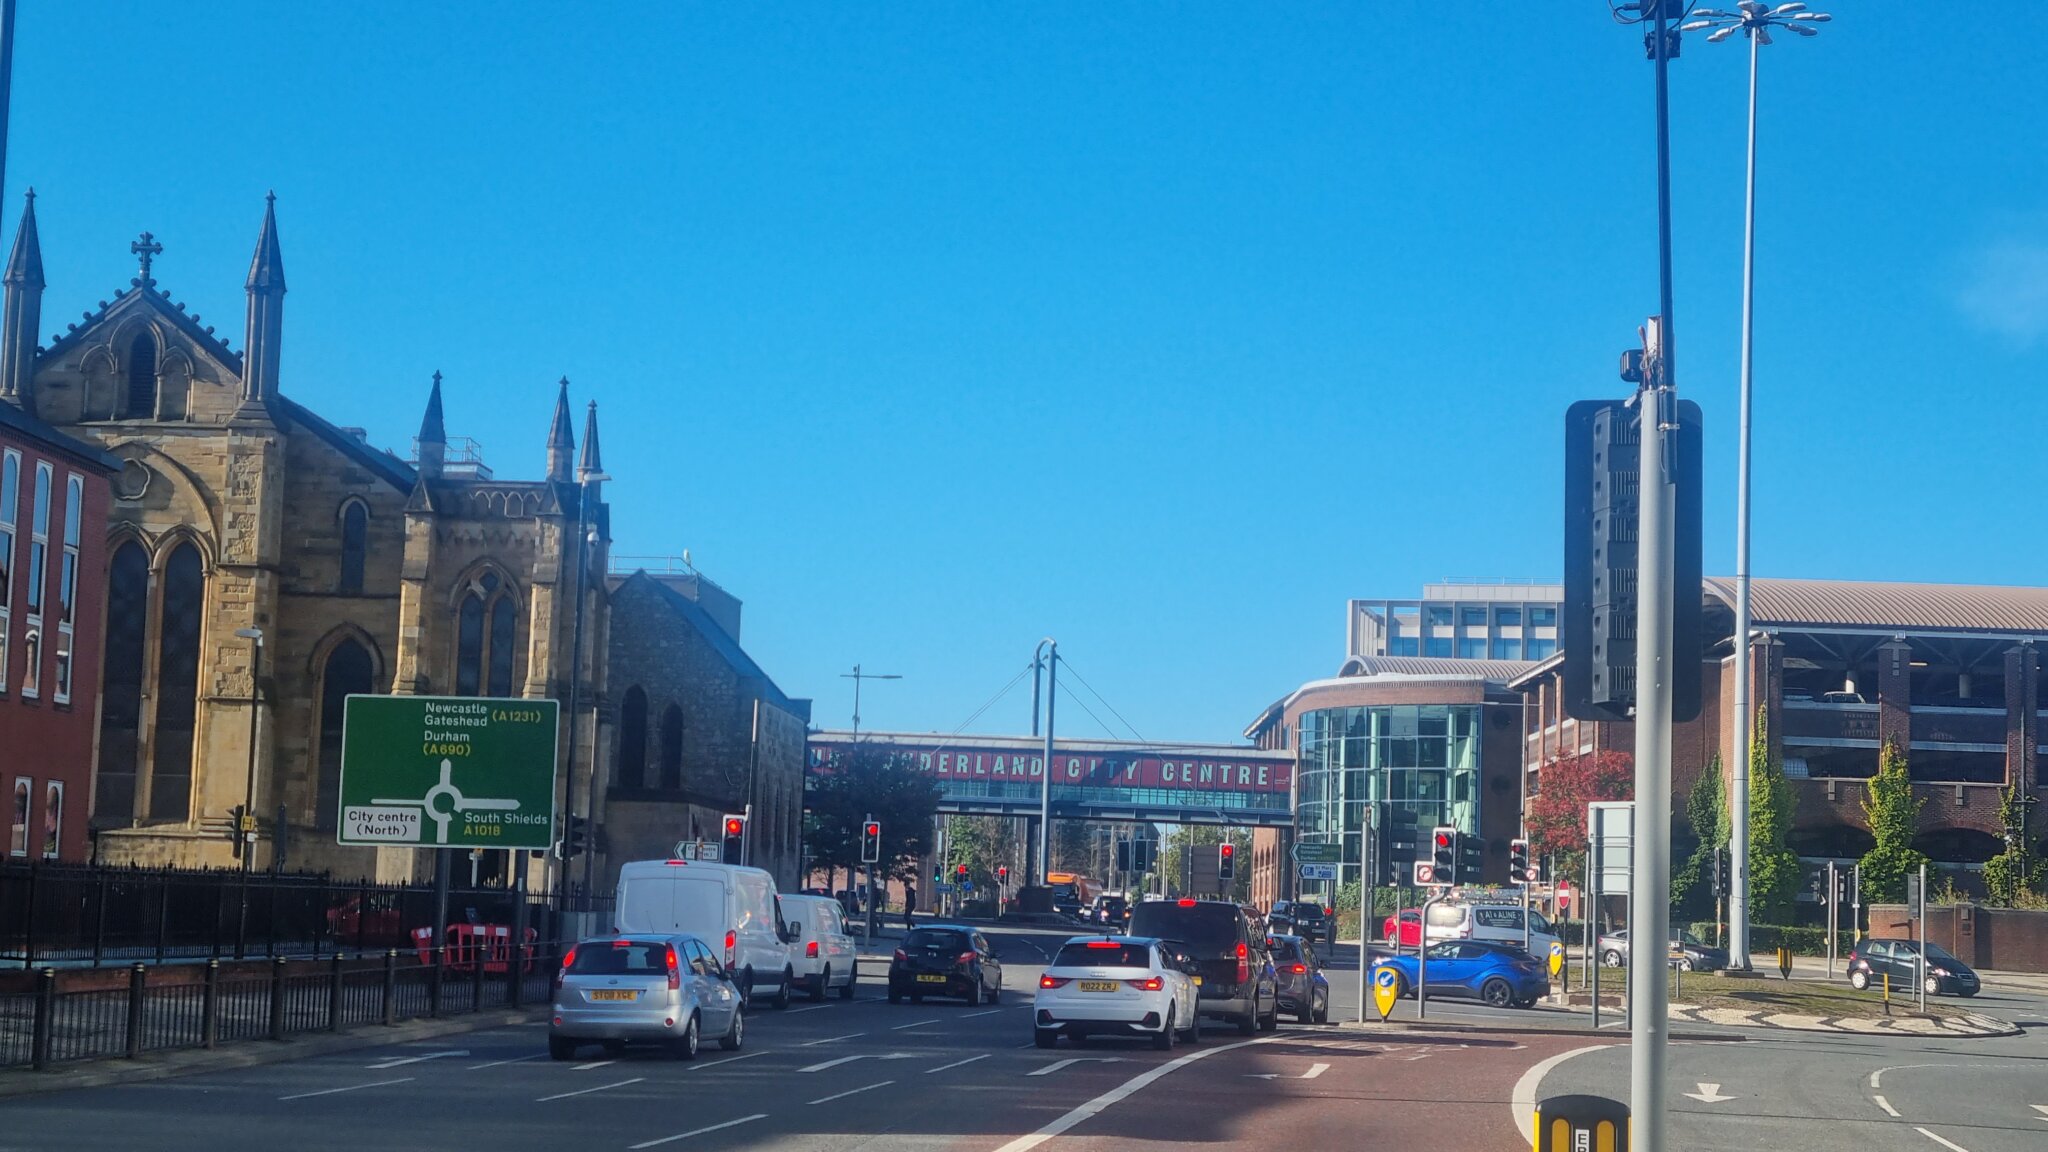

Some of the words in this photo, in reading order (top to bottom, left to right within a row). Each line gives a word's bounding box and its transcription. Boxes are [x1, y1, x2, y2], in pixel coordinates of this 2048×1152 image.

[425, 702, 488, 714] Newcastle
[424, 715, 488, 727] Gateshead
[492, 709, 542, 722] (A1231)
[424, 730, 470, 742] Durham
[423, 743, 471, 757] (A690)
[1068, 758, 1137, 780] CITY
[1162, 762, 1268, 785] CENTRE
[349, 811, 373, 823] City
[377, 813, 417, 823] centre
[464, 812, 500, 824] South
[504, 813, 548, 825] Shields
[356, 824, 408, 837] (North)
